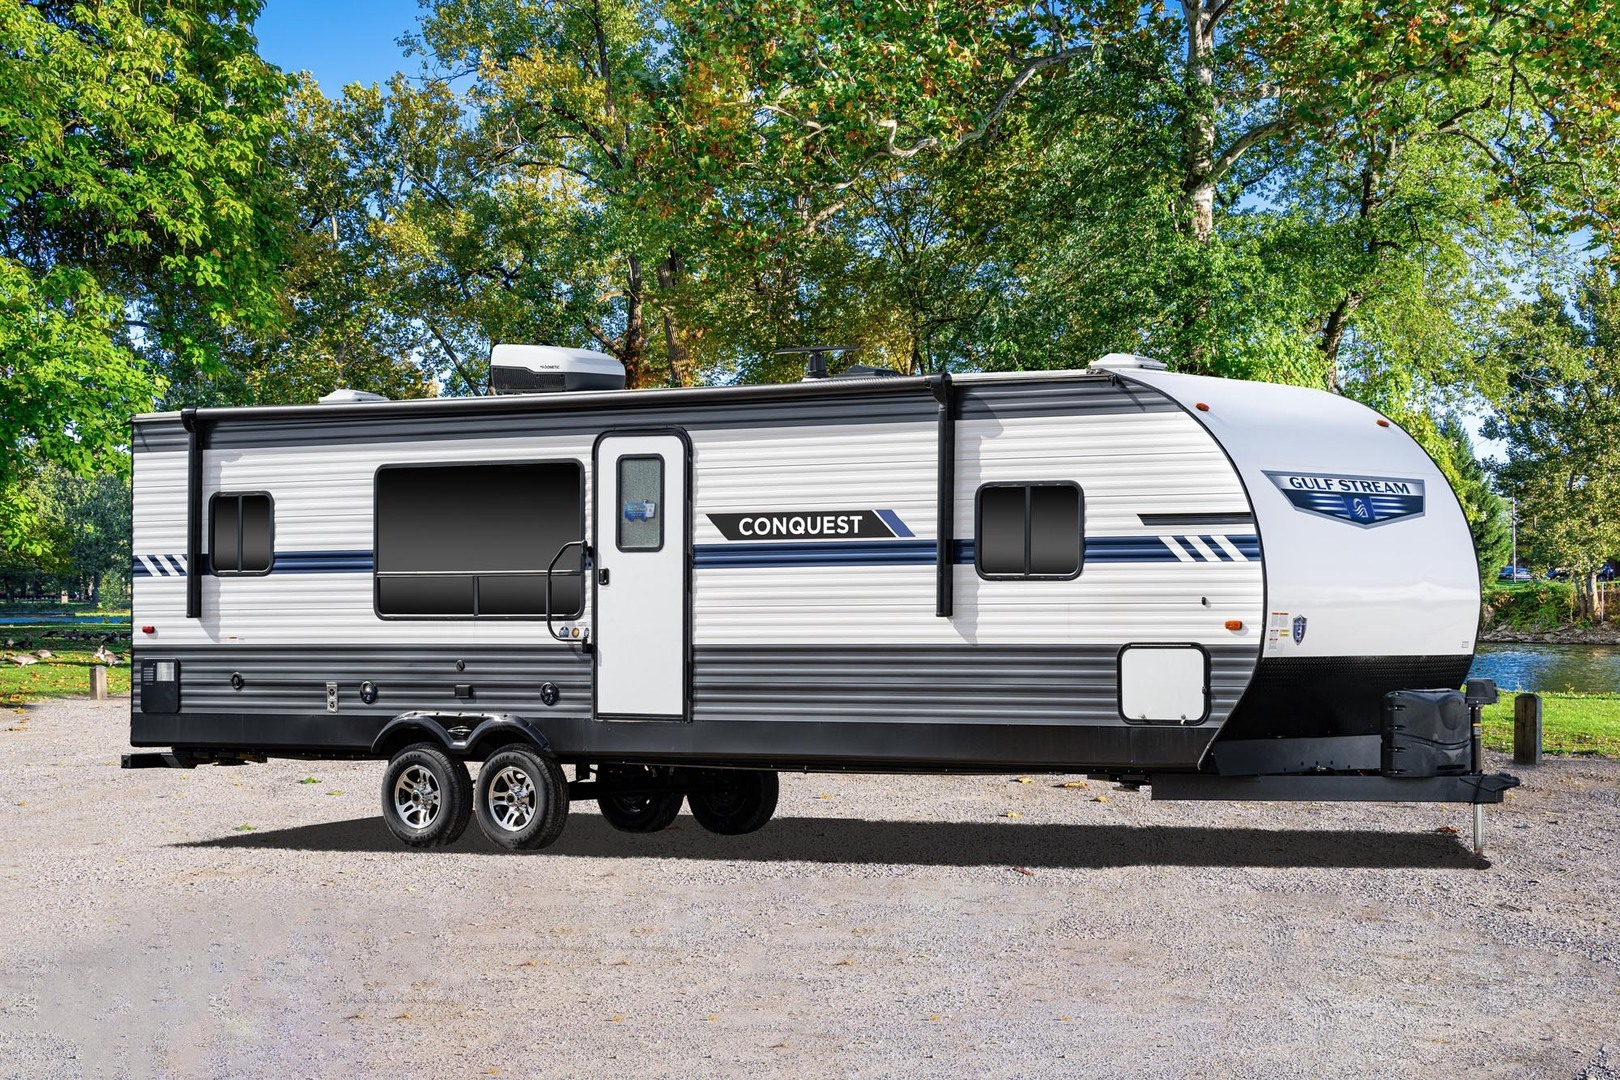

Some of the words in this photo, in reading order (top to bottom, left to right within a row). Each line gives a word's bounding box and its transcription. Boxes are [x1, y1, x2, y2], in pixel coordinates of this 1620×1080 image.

[1289, 476, 1333, 491] GULF
[1338, 479, 1411, 495] STREAM
[738, 515, 863, 536] CONQUEST
